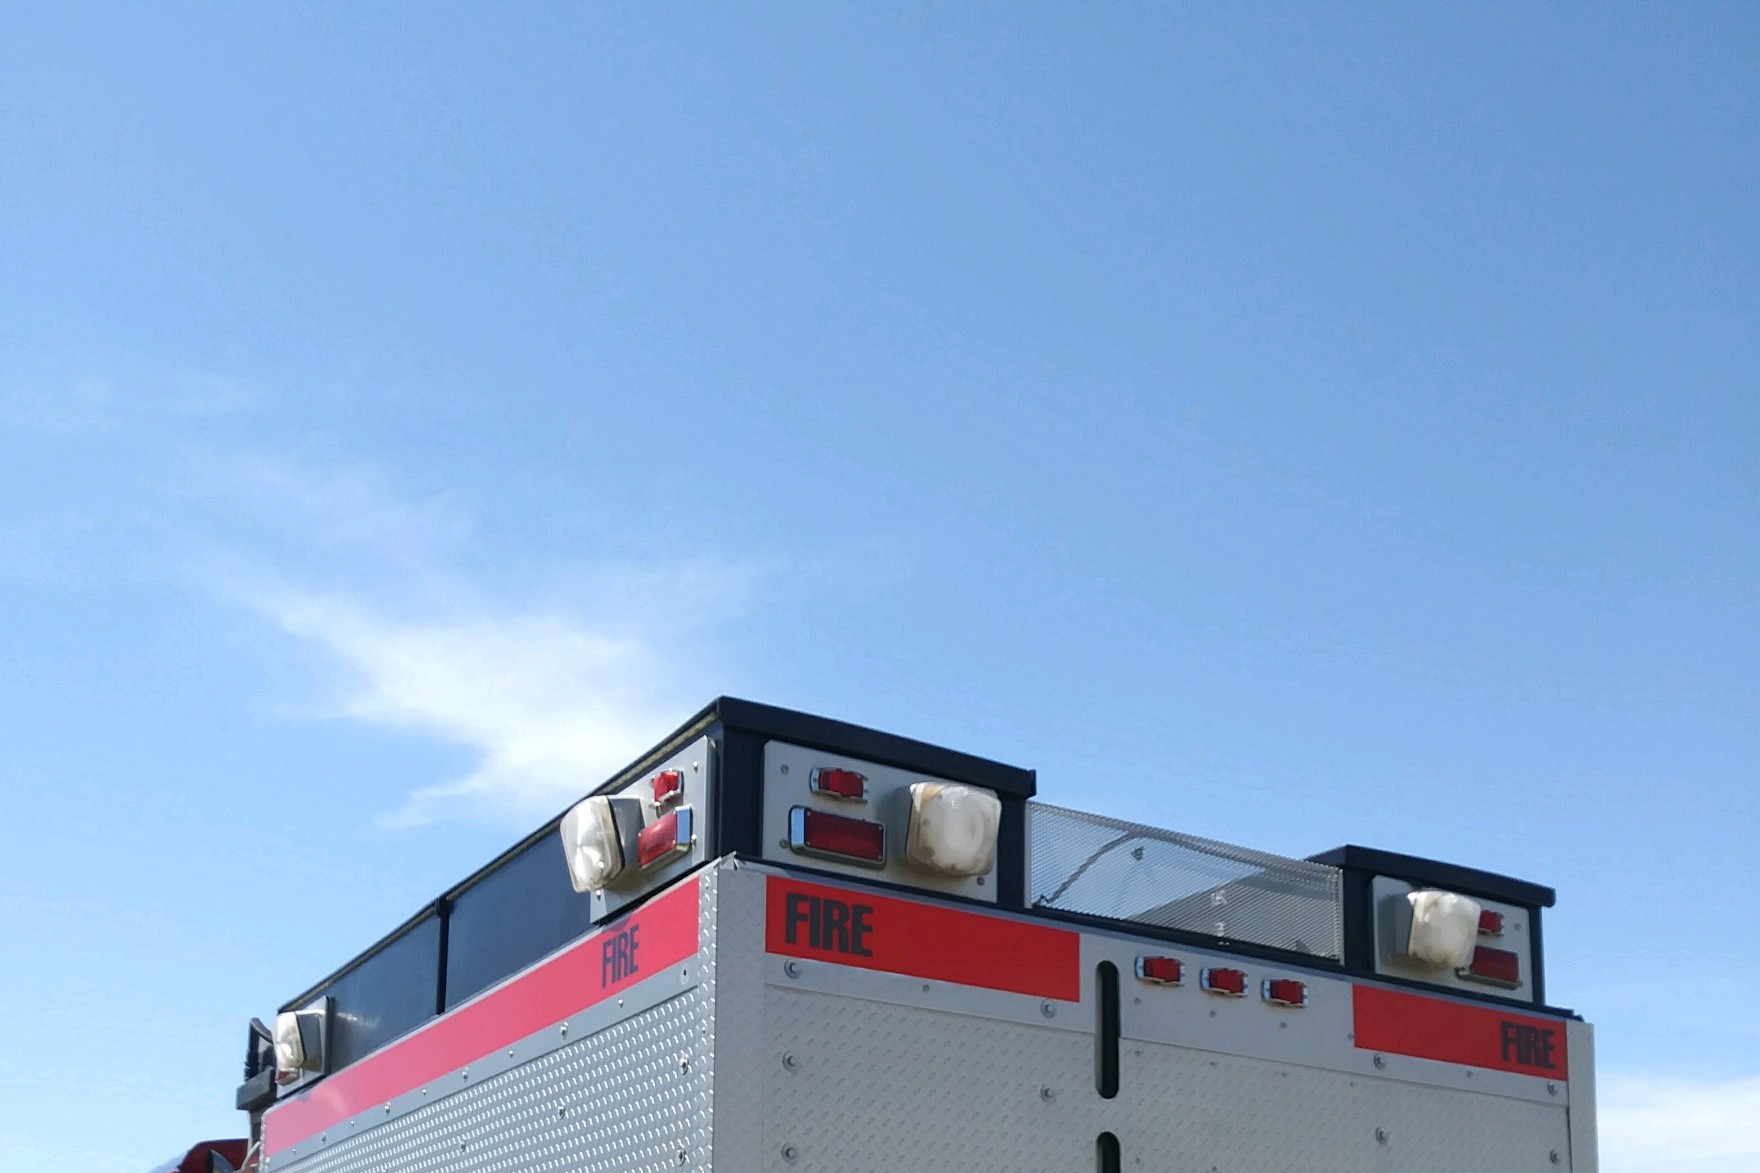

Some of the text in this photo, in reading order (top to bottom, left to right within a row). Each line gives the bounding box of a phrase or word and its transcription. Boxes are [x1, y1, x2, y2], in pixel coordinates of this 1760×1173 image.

[602, 924, 639, 988] FIRE
[786, 893, 873, 956] FIRE
[1501, 1021, 1556, 1069] FIRE
